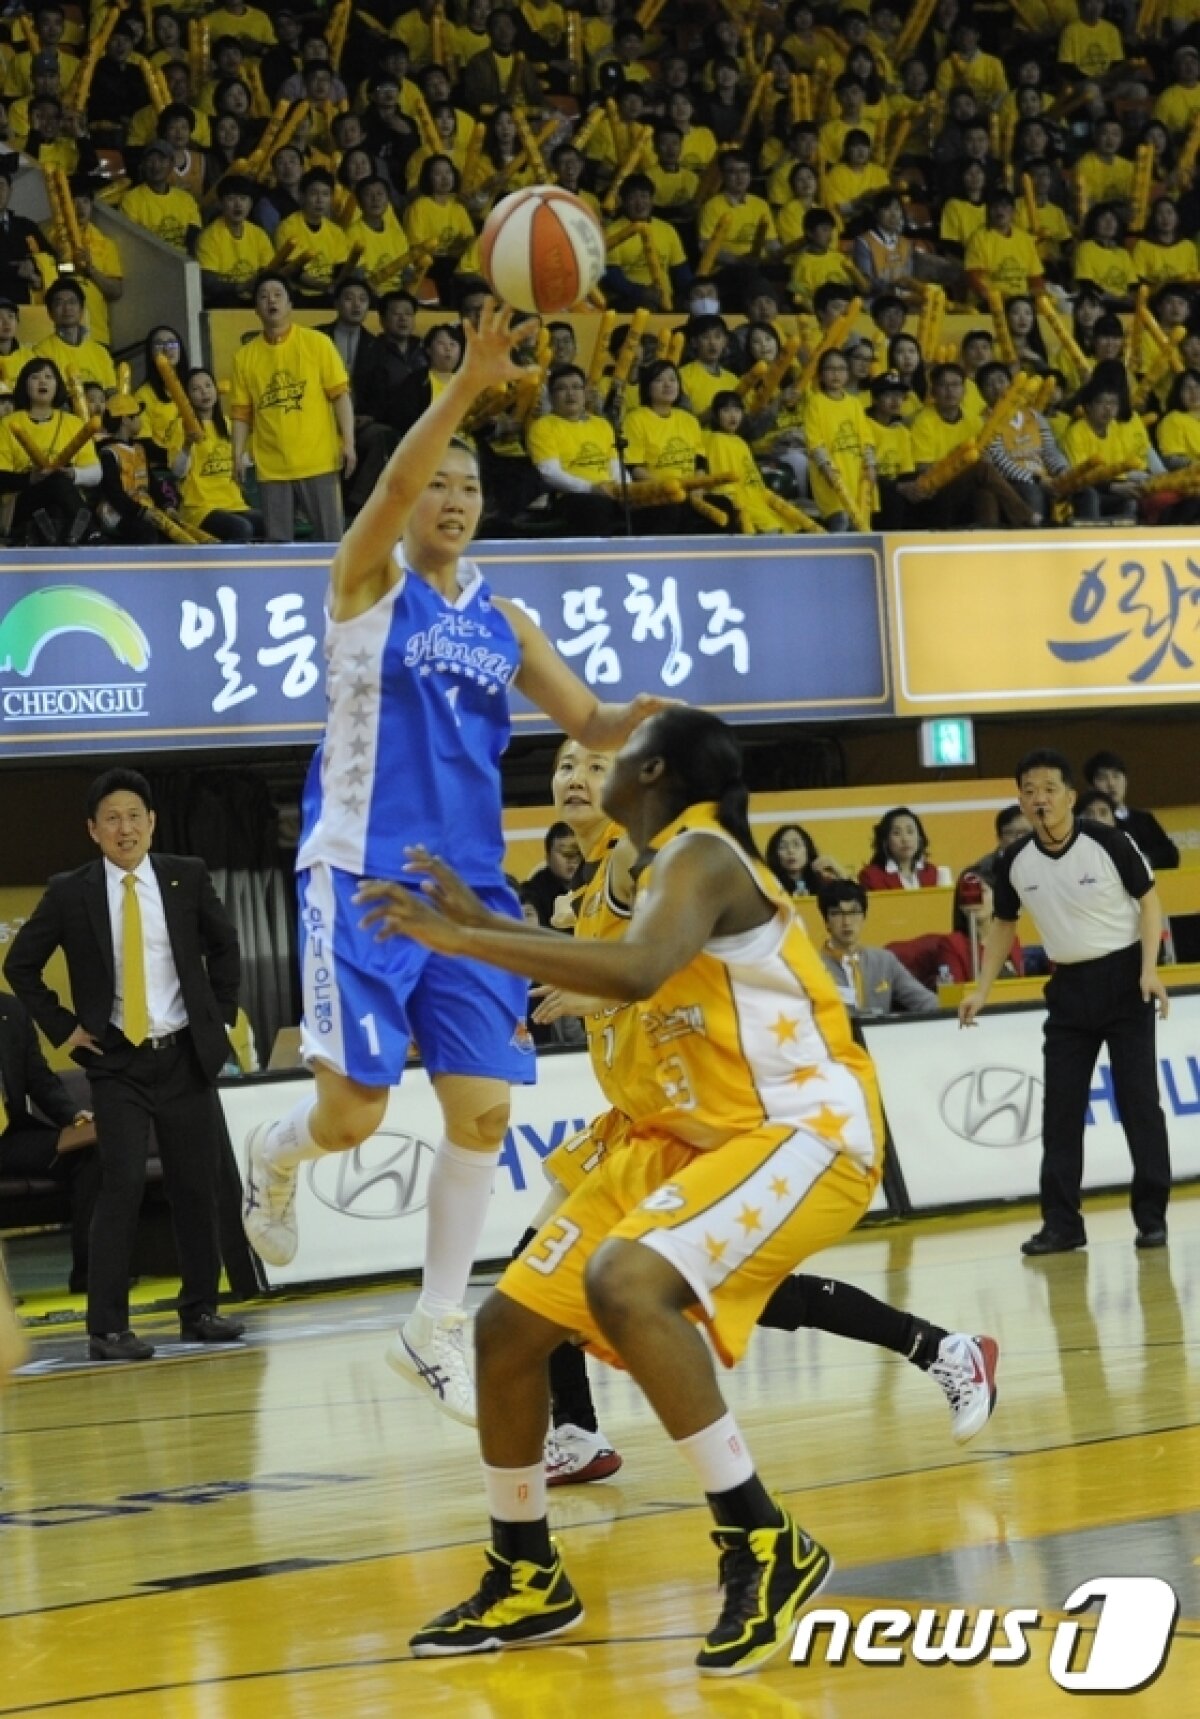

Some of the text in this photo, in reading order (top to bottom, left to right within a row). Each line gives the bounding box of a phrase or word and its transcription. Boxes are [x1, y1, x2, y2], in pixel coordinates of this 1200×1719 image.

[180, 572, 749, 713] 일등 뜸청주
[1046, 556, 1200, 683] 으랏
[3, 687, 144, 715] CHEONGJU
[359, 1013, 381, 1056] 1
[525, 1216, 582, 1275] 3
